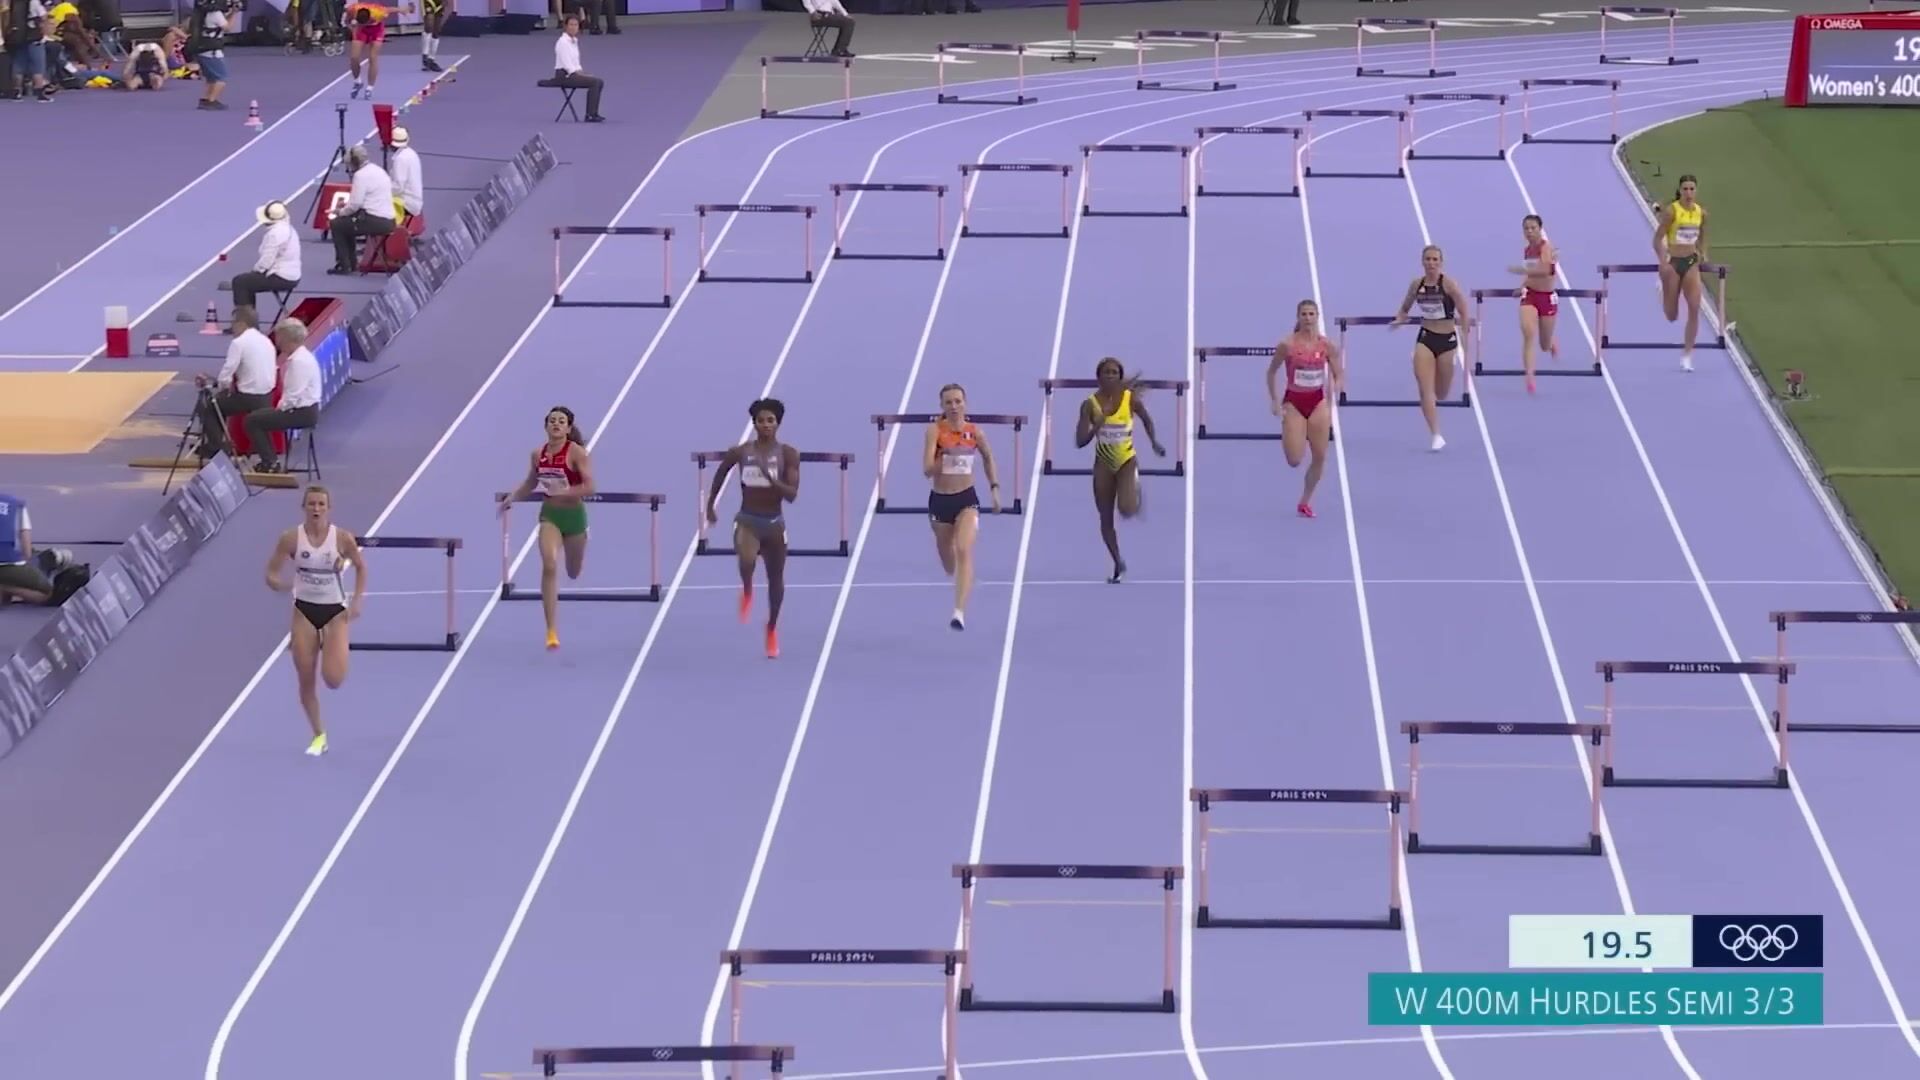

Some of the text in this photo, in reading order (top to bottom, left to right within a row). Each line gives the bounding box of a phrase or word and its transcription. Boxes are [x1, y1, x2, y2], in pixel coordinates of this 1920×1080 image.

[1823, 19, 1863, 29] OMEGA
[1809, 73, 1886, 96] Women's
[1669, 663, 1721, 672] PARIS 2024
[1270, 790, 1328, 800] PARIS 2024
[811, 952, 875, 962] PARIS 2024
